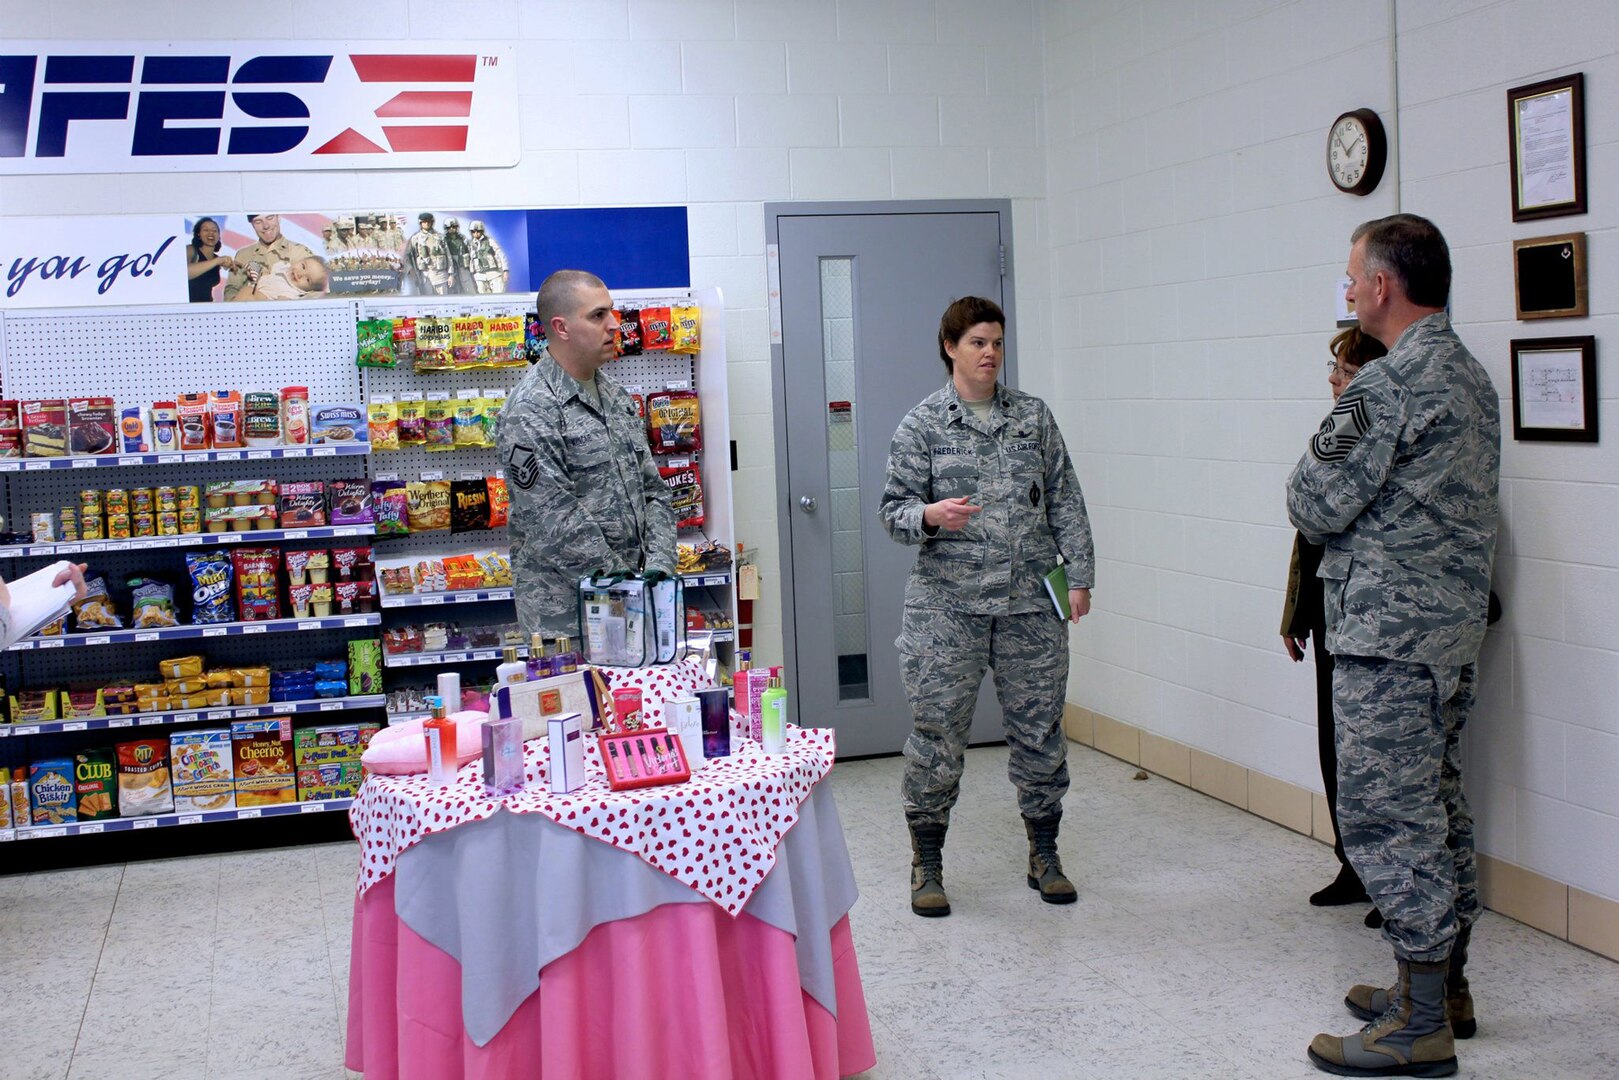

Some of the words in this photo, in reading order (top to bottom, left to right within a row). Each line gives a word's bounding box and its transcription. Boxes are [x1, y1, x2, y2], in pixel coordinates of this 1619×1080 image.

[482, 56, 498, 66] TM
[7, 255, 91, 298] you
[97, 236, 177, 295] go!
[420, 324, 450, 334] HARIBO
[455, 320, 484, 331] HARIBO
[490, 322, 519, 332] HARIBO
[251, 394, 272, 402] Brew
[933, 447, 973, 456] FREDERICK
[290, 485, 297, 493] 2
[338, 489, 365, 498] Delights
[409, 490, 451, 501] Werther's
[289, 500, 315, 508] Delights
[420, 498, 450, 509] Original
[378, 510, 399, 521] Taffy
[288, 552, 308, 562] Snack
[335, 550, 356, 561] Snack
[291, 585, 311, 597] Snack
[337, 582, 357, 593] Snack
[253, 741, 270, 749] Honey
[135, 746, 154, 762] RITZ
[181, 750, 219, 766] Cinnamon
[240, 746, 285, 760] Cheerios
[125, 765, 148, 773] TOASTED
[194, 757, 213, 770] Toast
[76, 763, 112, 781] CLUB
[193, 761, 220, 780] Crunch
[35, 783, 71, 793] Chicken
[39, 792, 67, 803] Biskit
